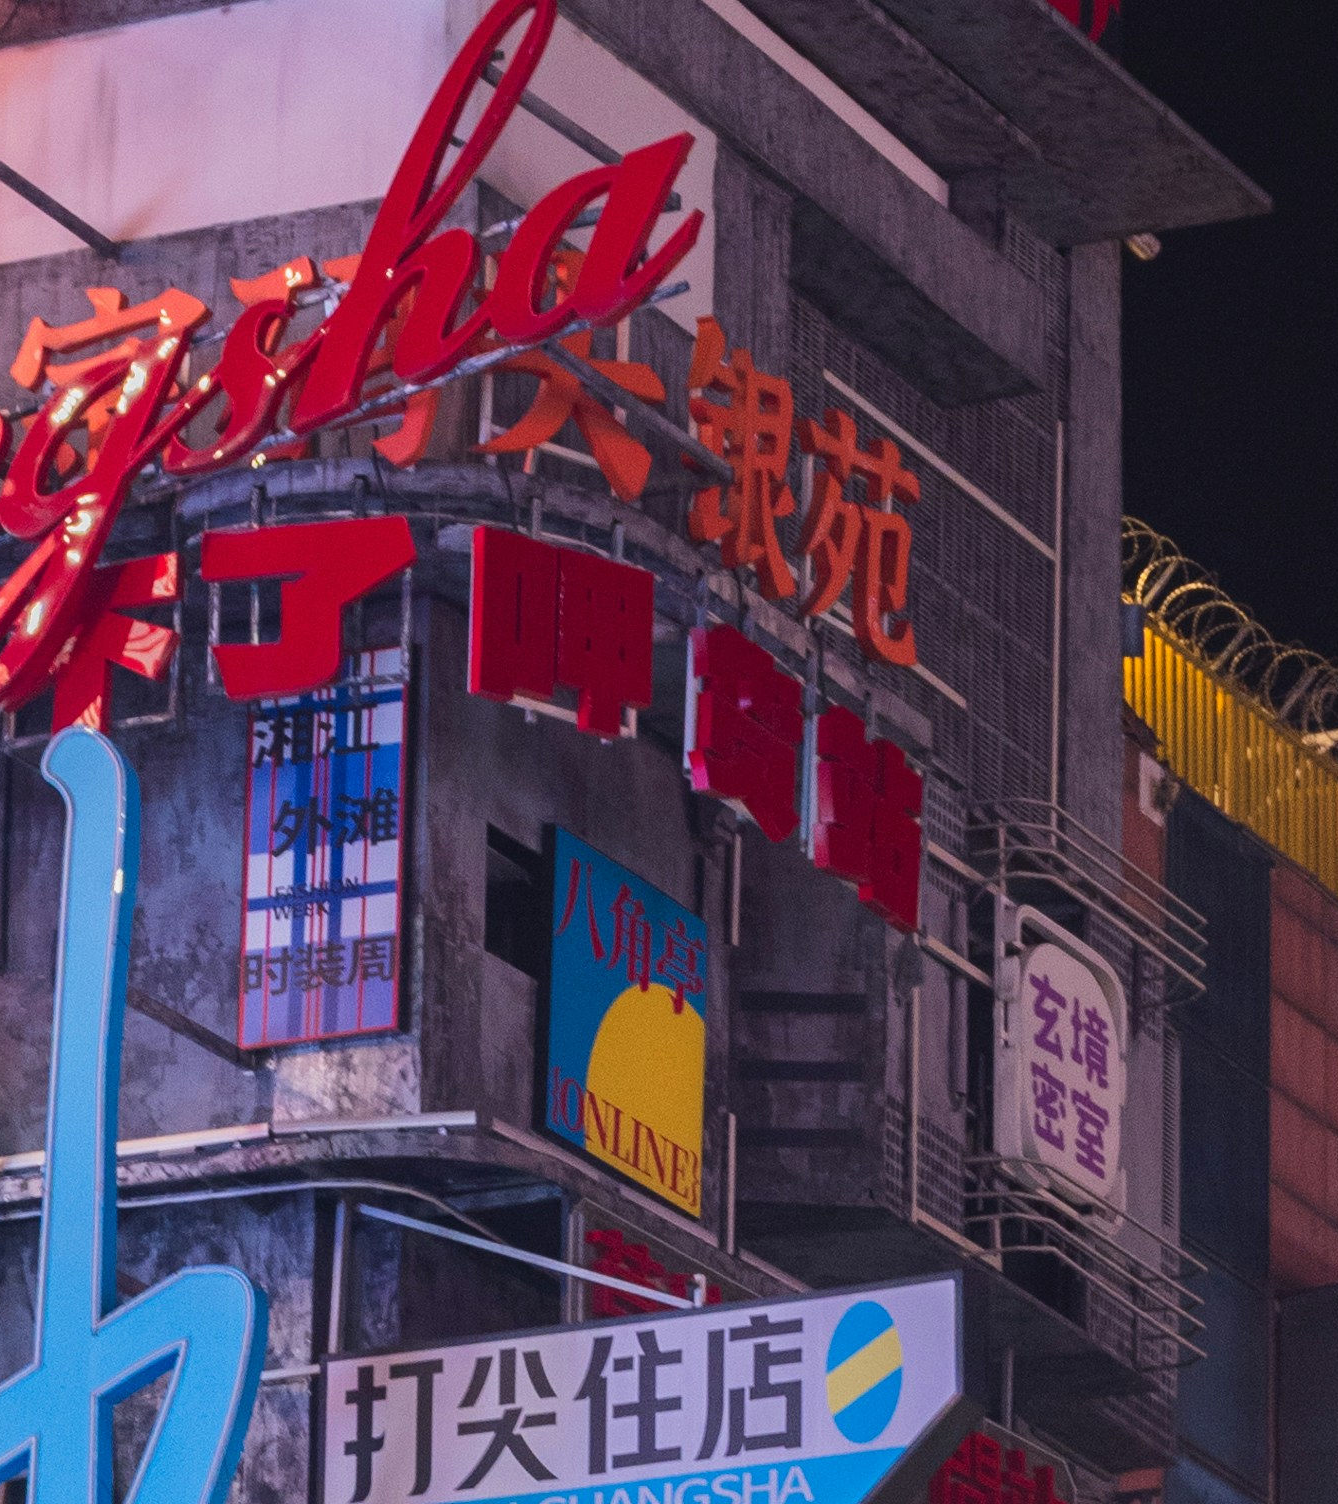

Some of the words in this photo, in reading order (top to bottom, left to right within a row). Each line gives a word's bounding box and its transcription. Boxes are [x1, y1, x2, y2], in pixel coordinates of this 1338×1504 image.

[253, 701, 379, 768] 湘江
[270, 787, 399, 857] 外滩
[273, 901, 329, 920] WEEK
[274, 876, 359, 899] FASHION
[244, 936, 395, 996] 时装周
[557, 857, 704, 1015] 八角亭
[345, 1315, 803, 1504] 打尖住店
